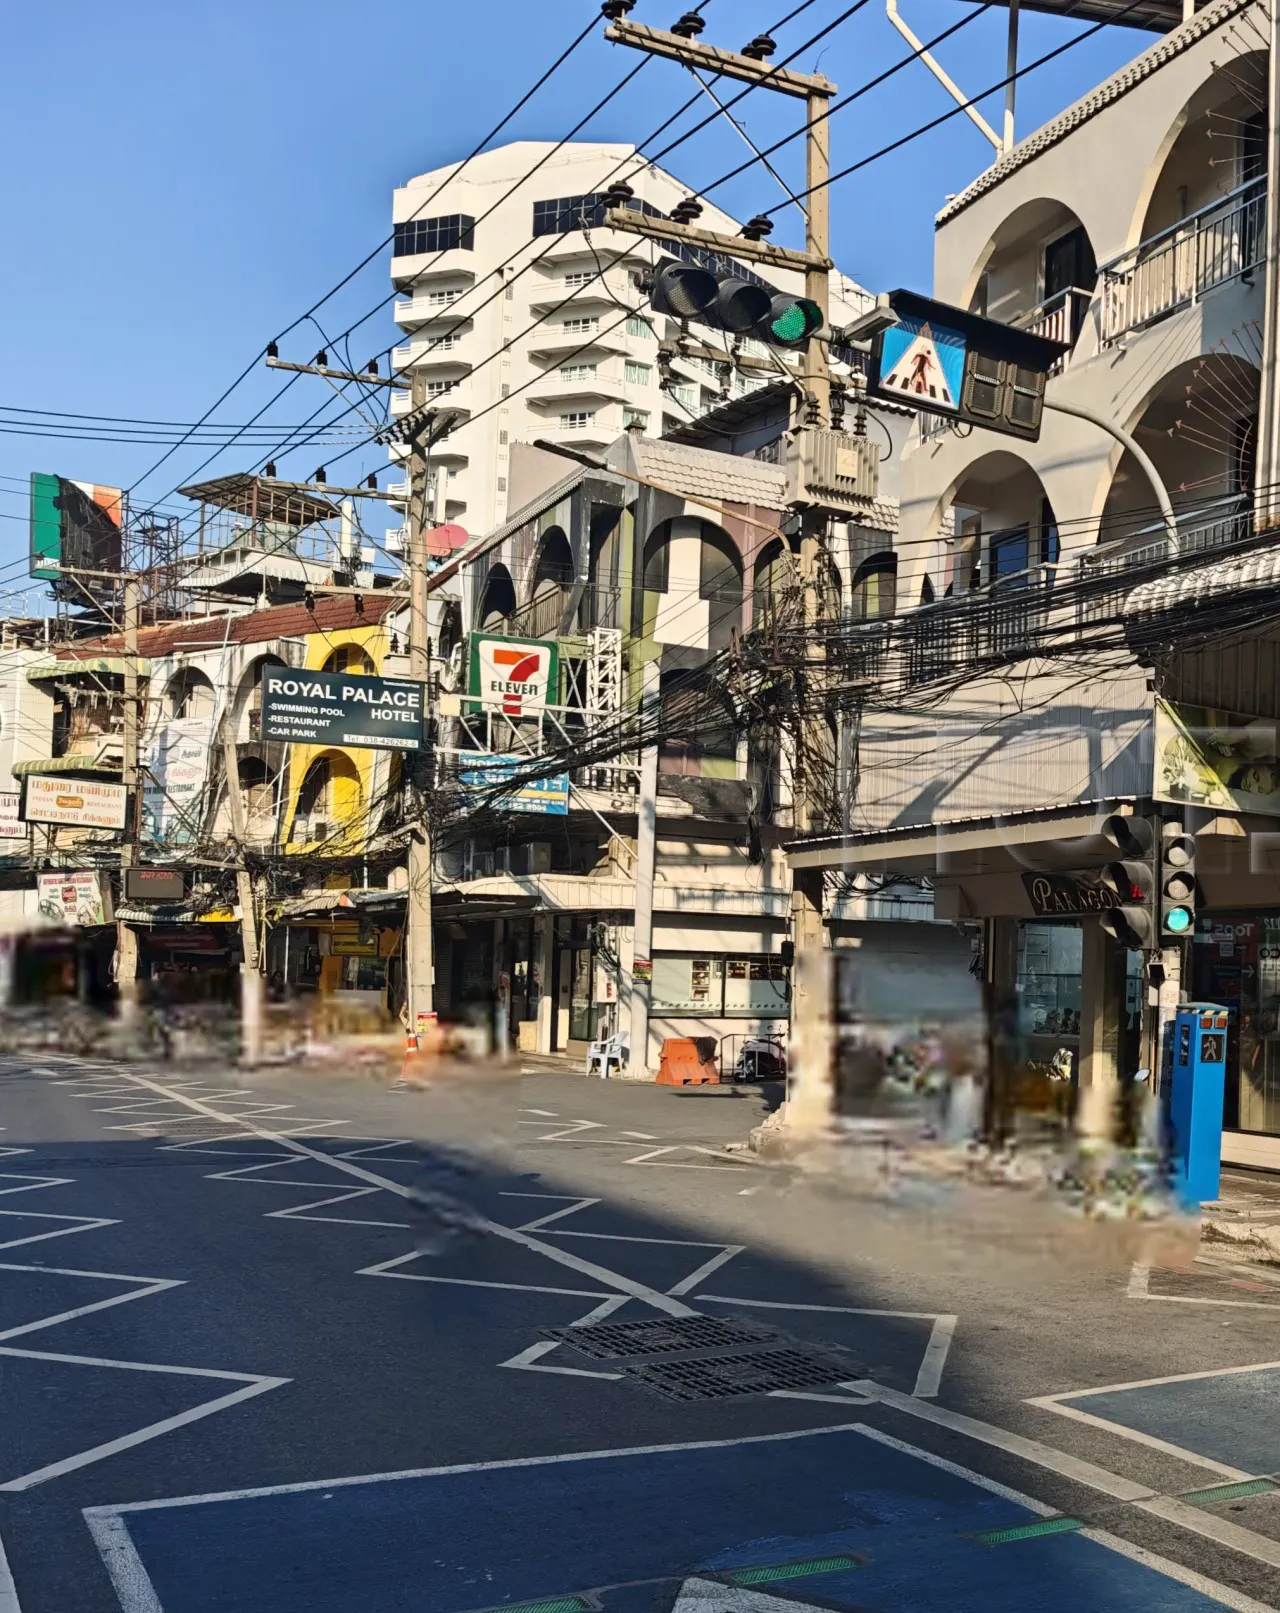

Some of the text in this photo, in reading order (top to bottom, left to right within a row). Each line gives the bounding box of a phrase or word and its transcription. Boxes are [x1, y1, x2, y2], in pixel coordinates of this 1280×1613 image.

[268, 678, 420, 708] ROYAL PALACE
[320, 707, 345, 717] POOL
[371, 708, 420, 723] HOTEL
[292, 729, 317, 738] PARK
